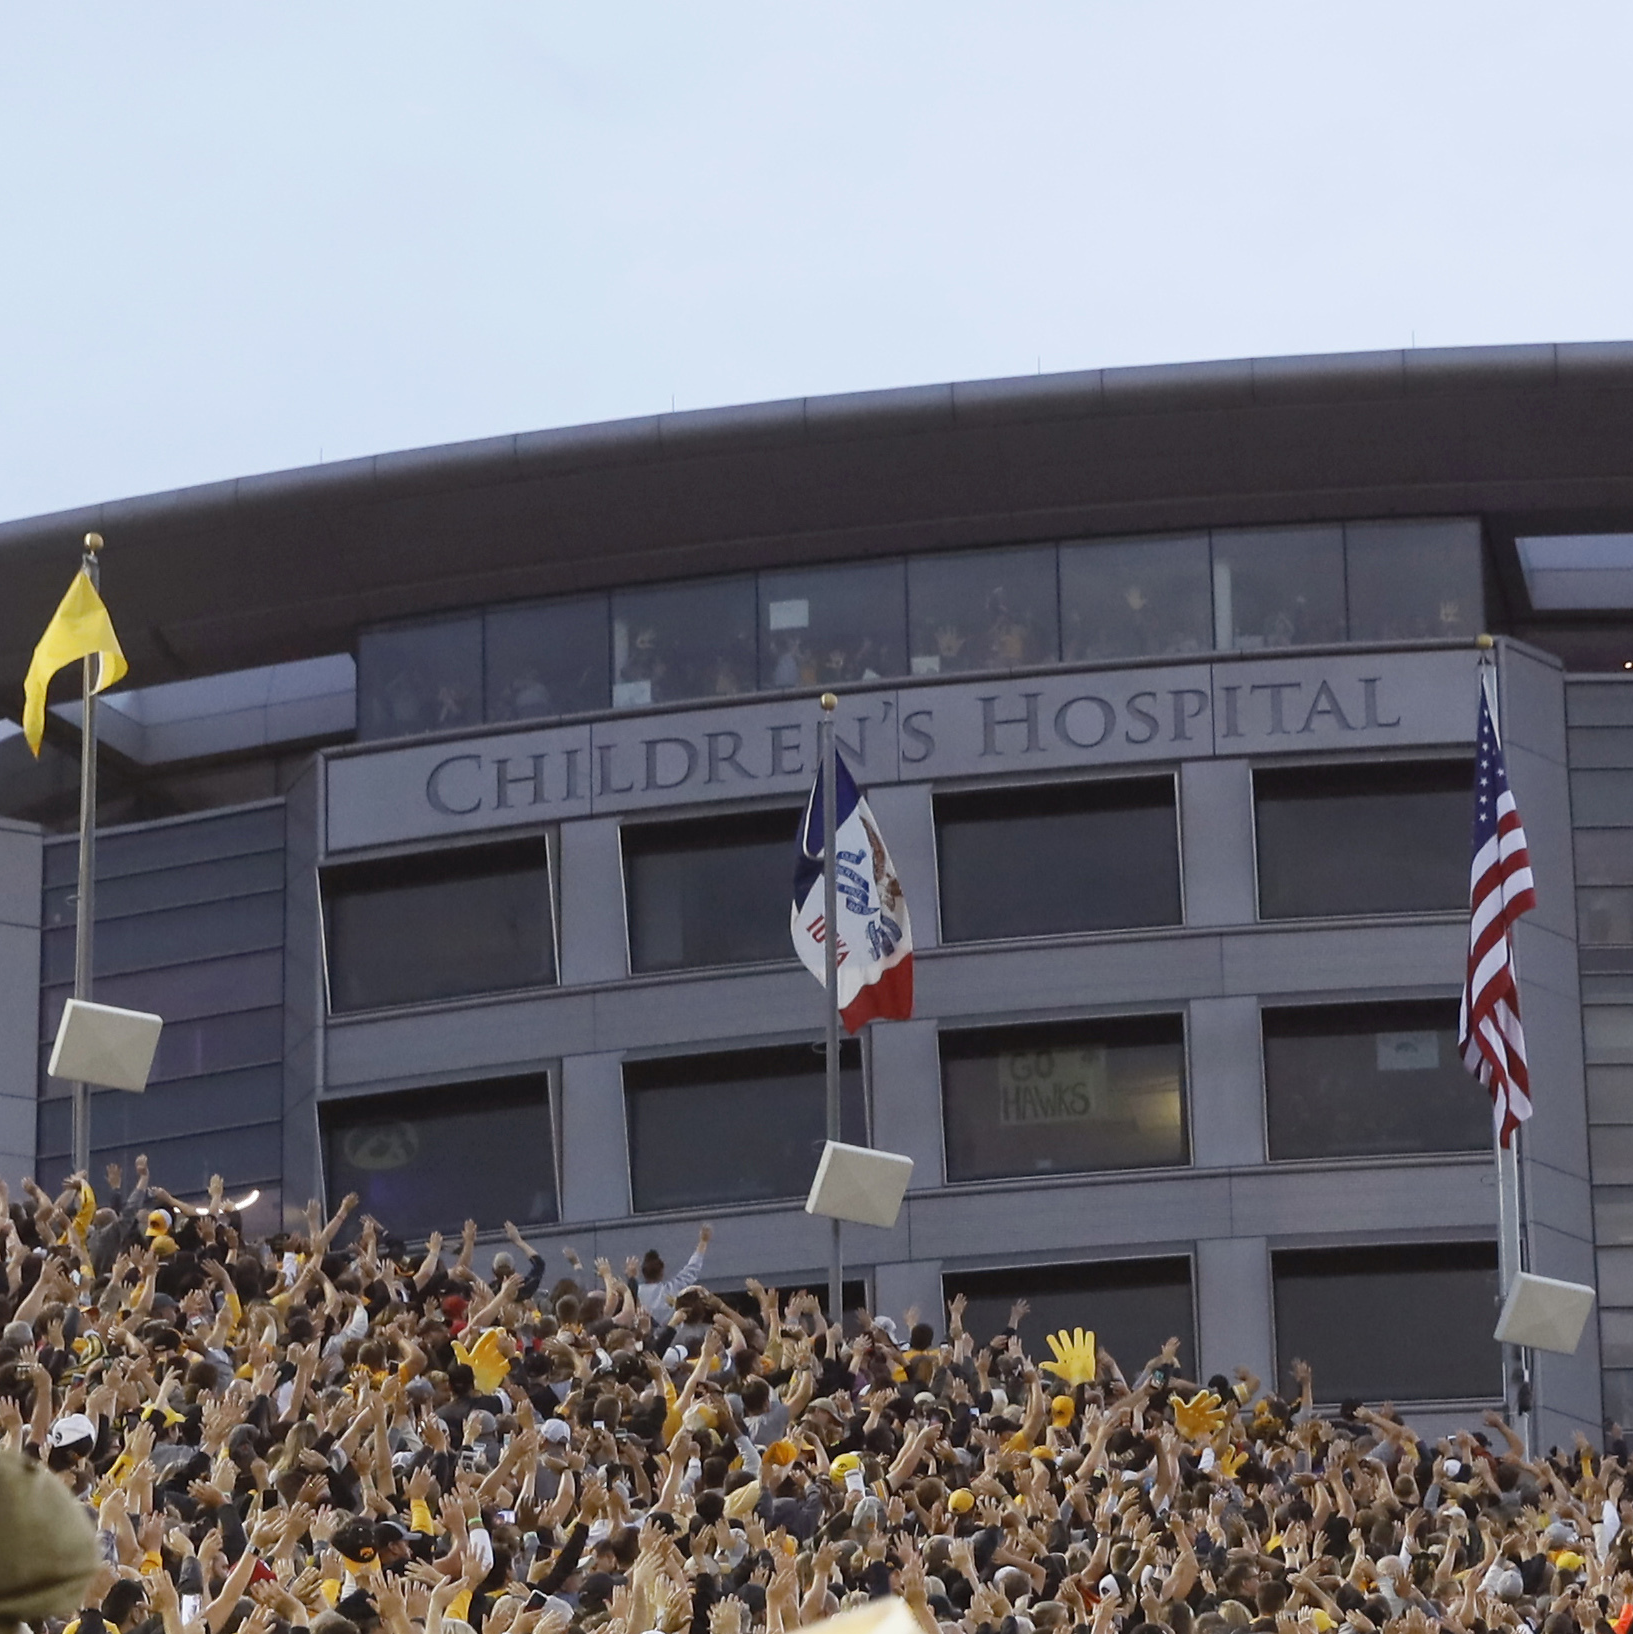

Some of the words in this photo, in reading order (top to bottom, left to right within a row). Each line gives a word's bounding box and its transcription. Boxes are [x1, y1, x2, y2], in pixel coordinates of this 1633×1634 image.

[425, 700, 936, 817] CHILDREN'S
[978, 675, 1402, 758] HOSPITAL
[1009, 1049, 1056, 1081] GO
[1002, 1081, 1091, 1120] HAWKS
